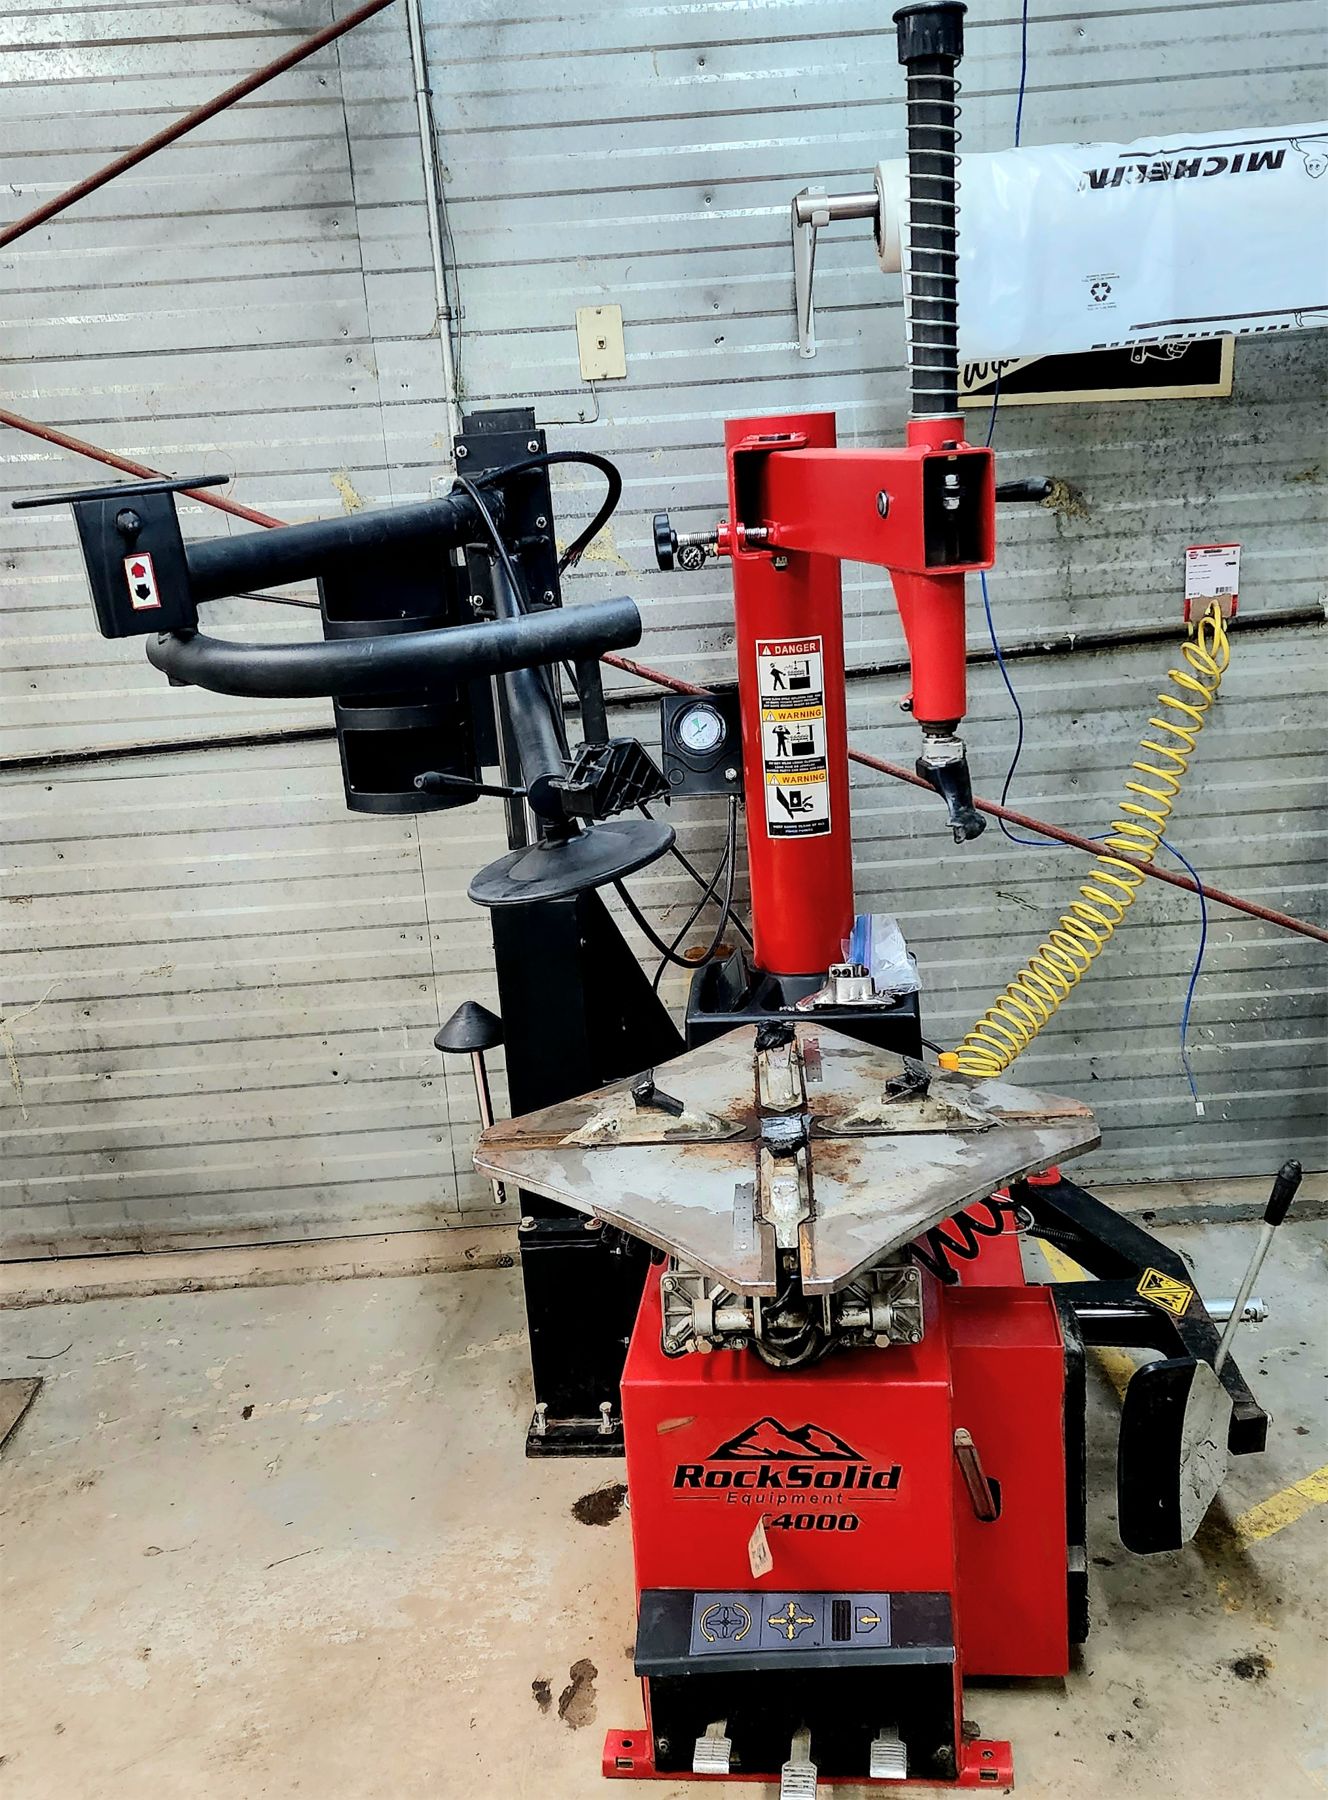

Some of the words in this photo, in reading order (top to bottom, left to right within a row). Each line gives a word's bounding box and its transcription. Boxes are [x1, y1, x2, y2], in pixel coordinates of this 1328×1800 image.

[775, 642, 816, 654] DANGER
[778, 709, 822, 719] WARNING
[782, 773, 825, 783] WARNING
[673, 1462, 902, 1490] RockSolid
[726, 1491, 843, 1505] Equipment
